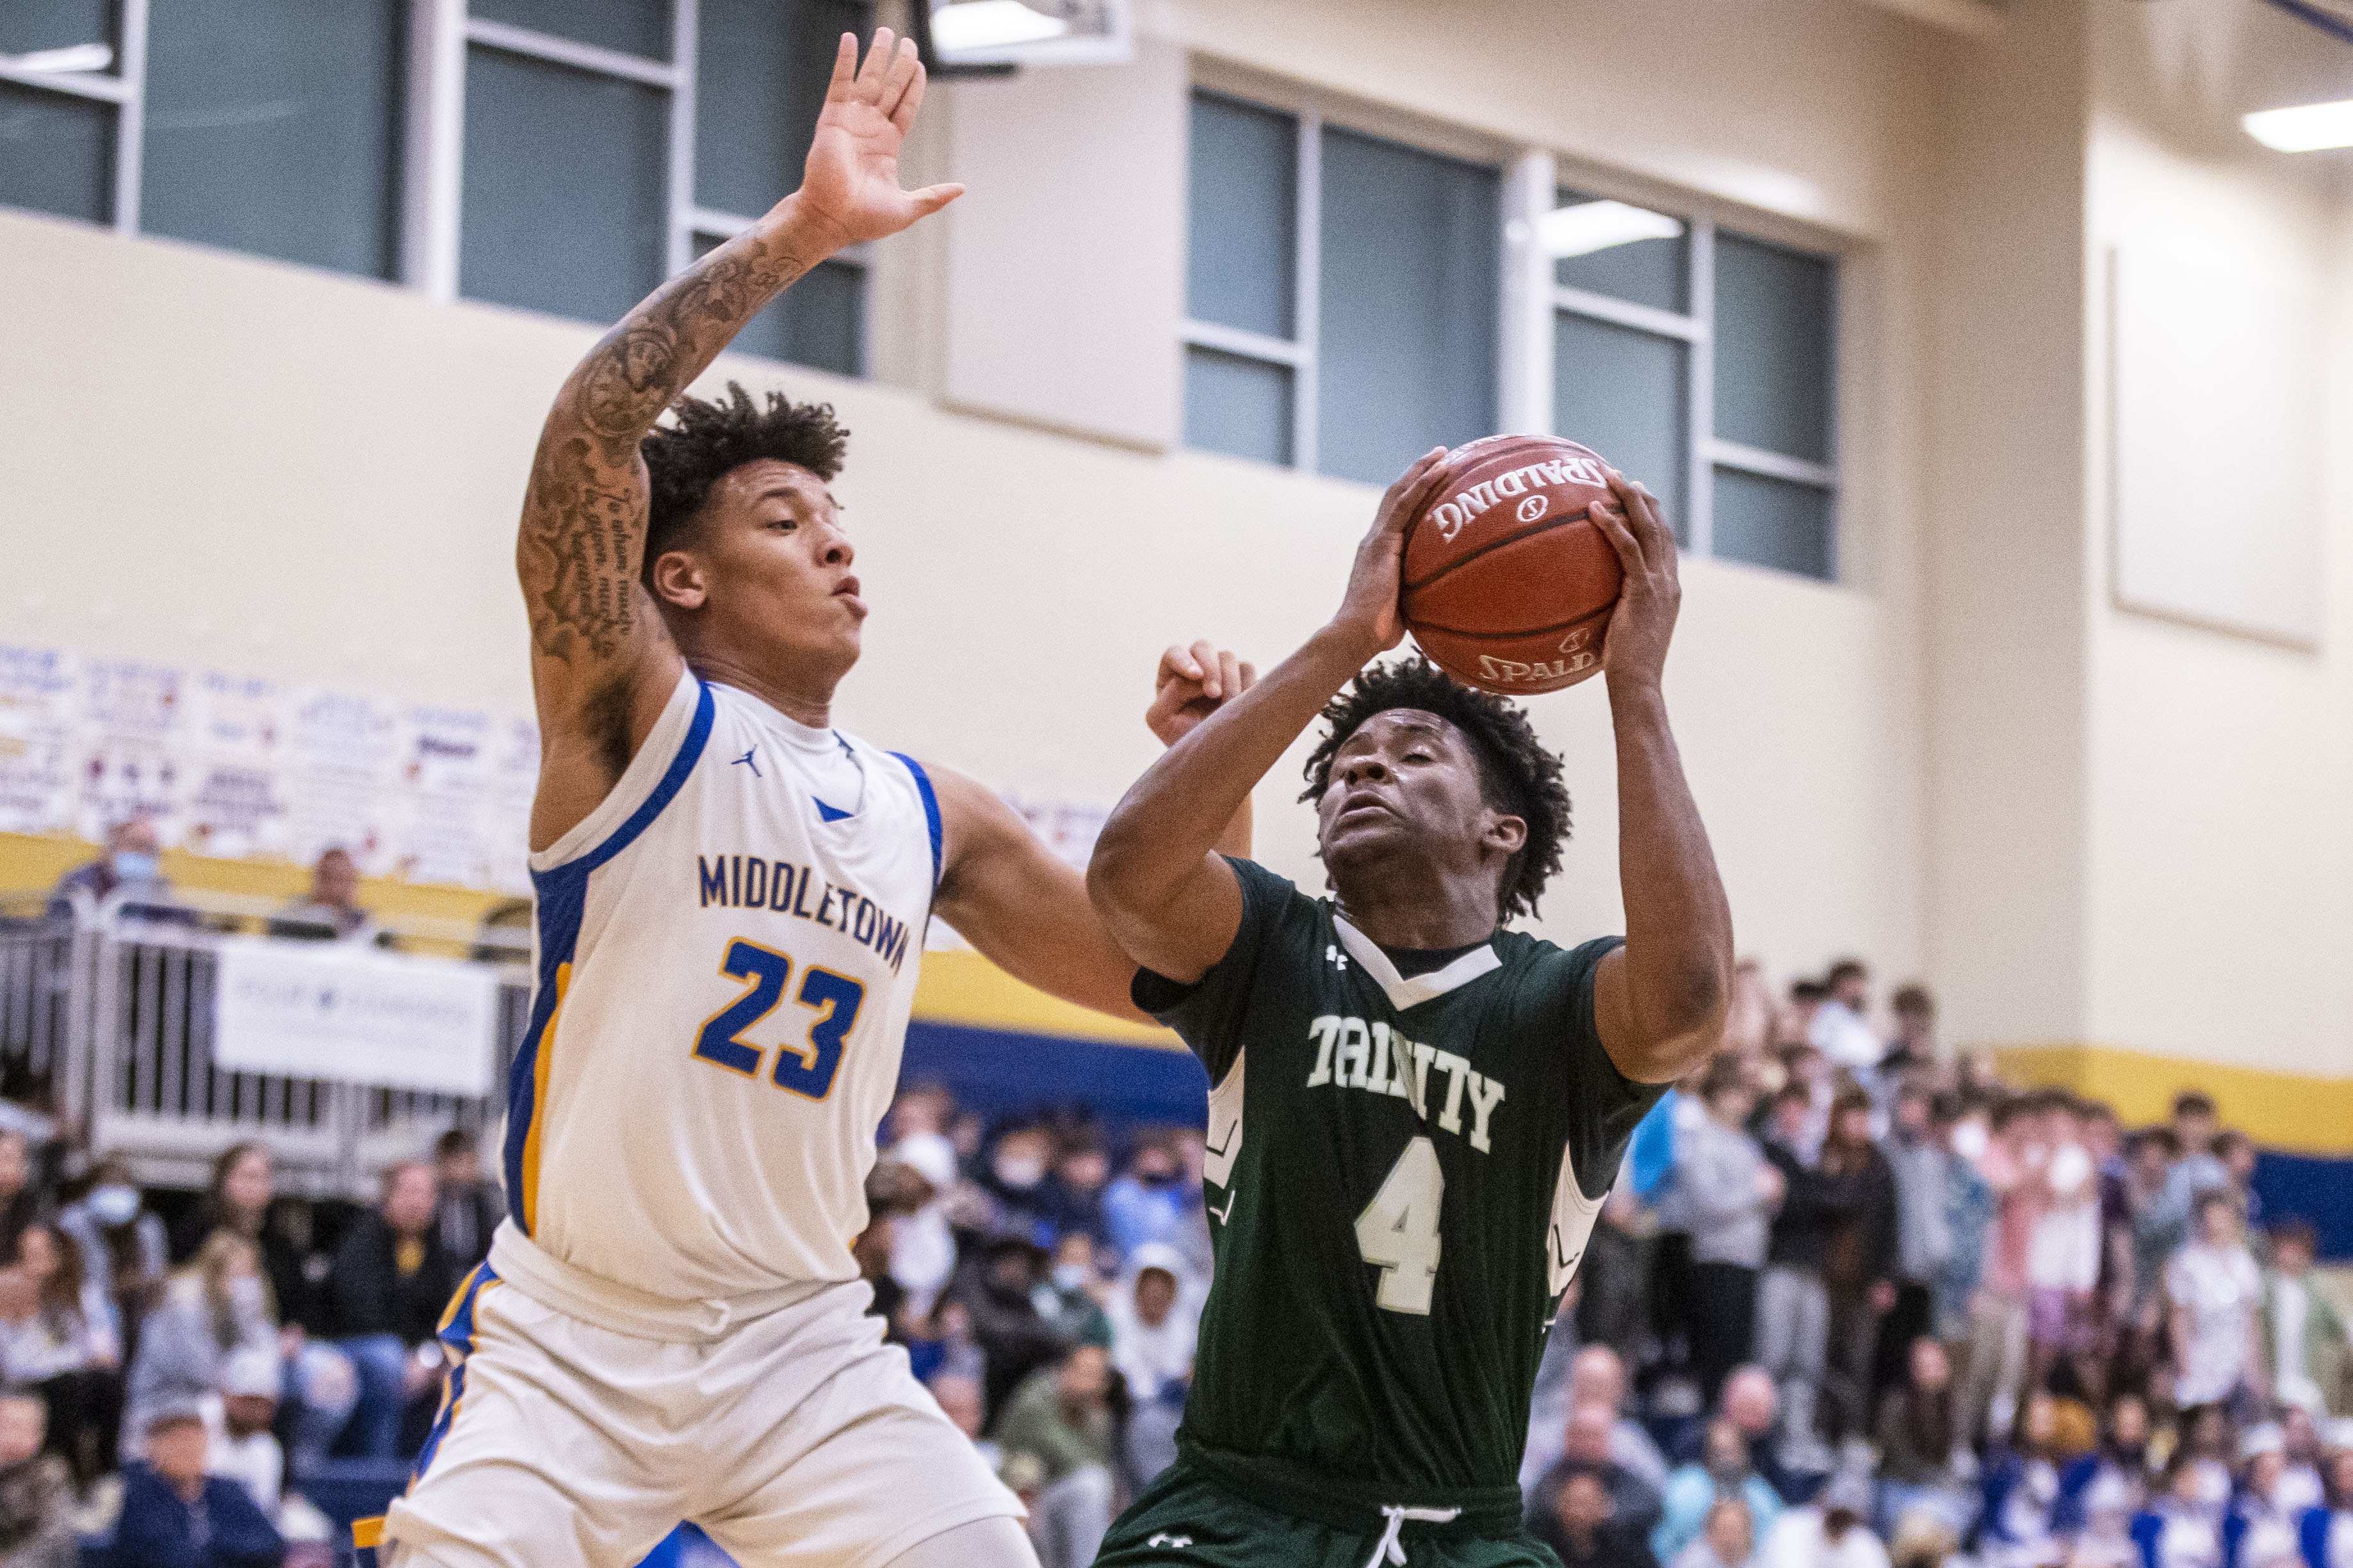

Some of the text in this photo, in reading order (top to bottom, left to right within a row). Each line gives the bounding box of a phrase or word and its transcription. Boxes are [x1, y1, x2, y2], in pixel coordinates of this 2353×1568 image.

[1431, 457, 1607, 544] SPALDING
[1479, 651, 1595, 683] SPALD
[697, 854, 911, 978] MIDDLETOWN
[690, 935, 867, 1103] 23
[1353, 1136, 1446, 1316] 4
